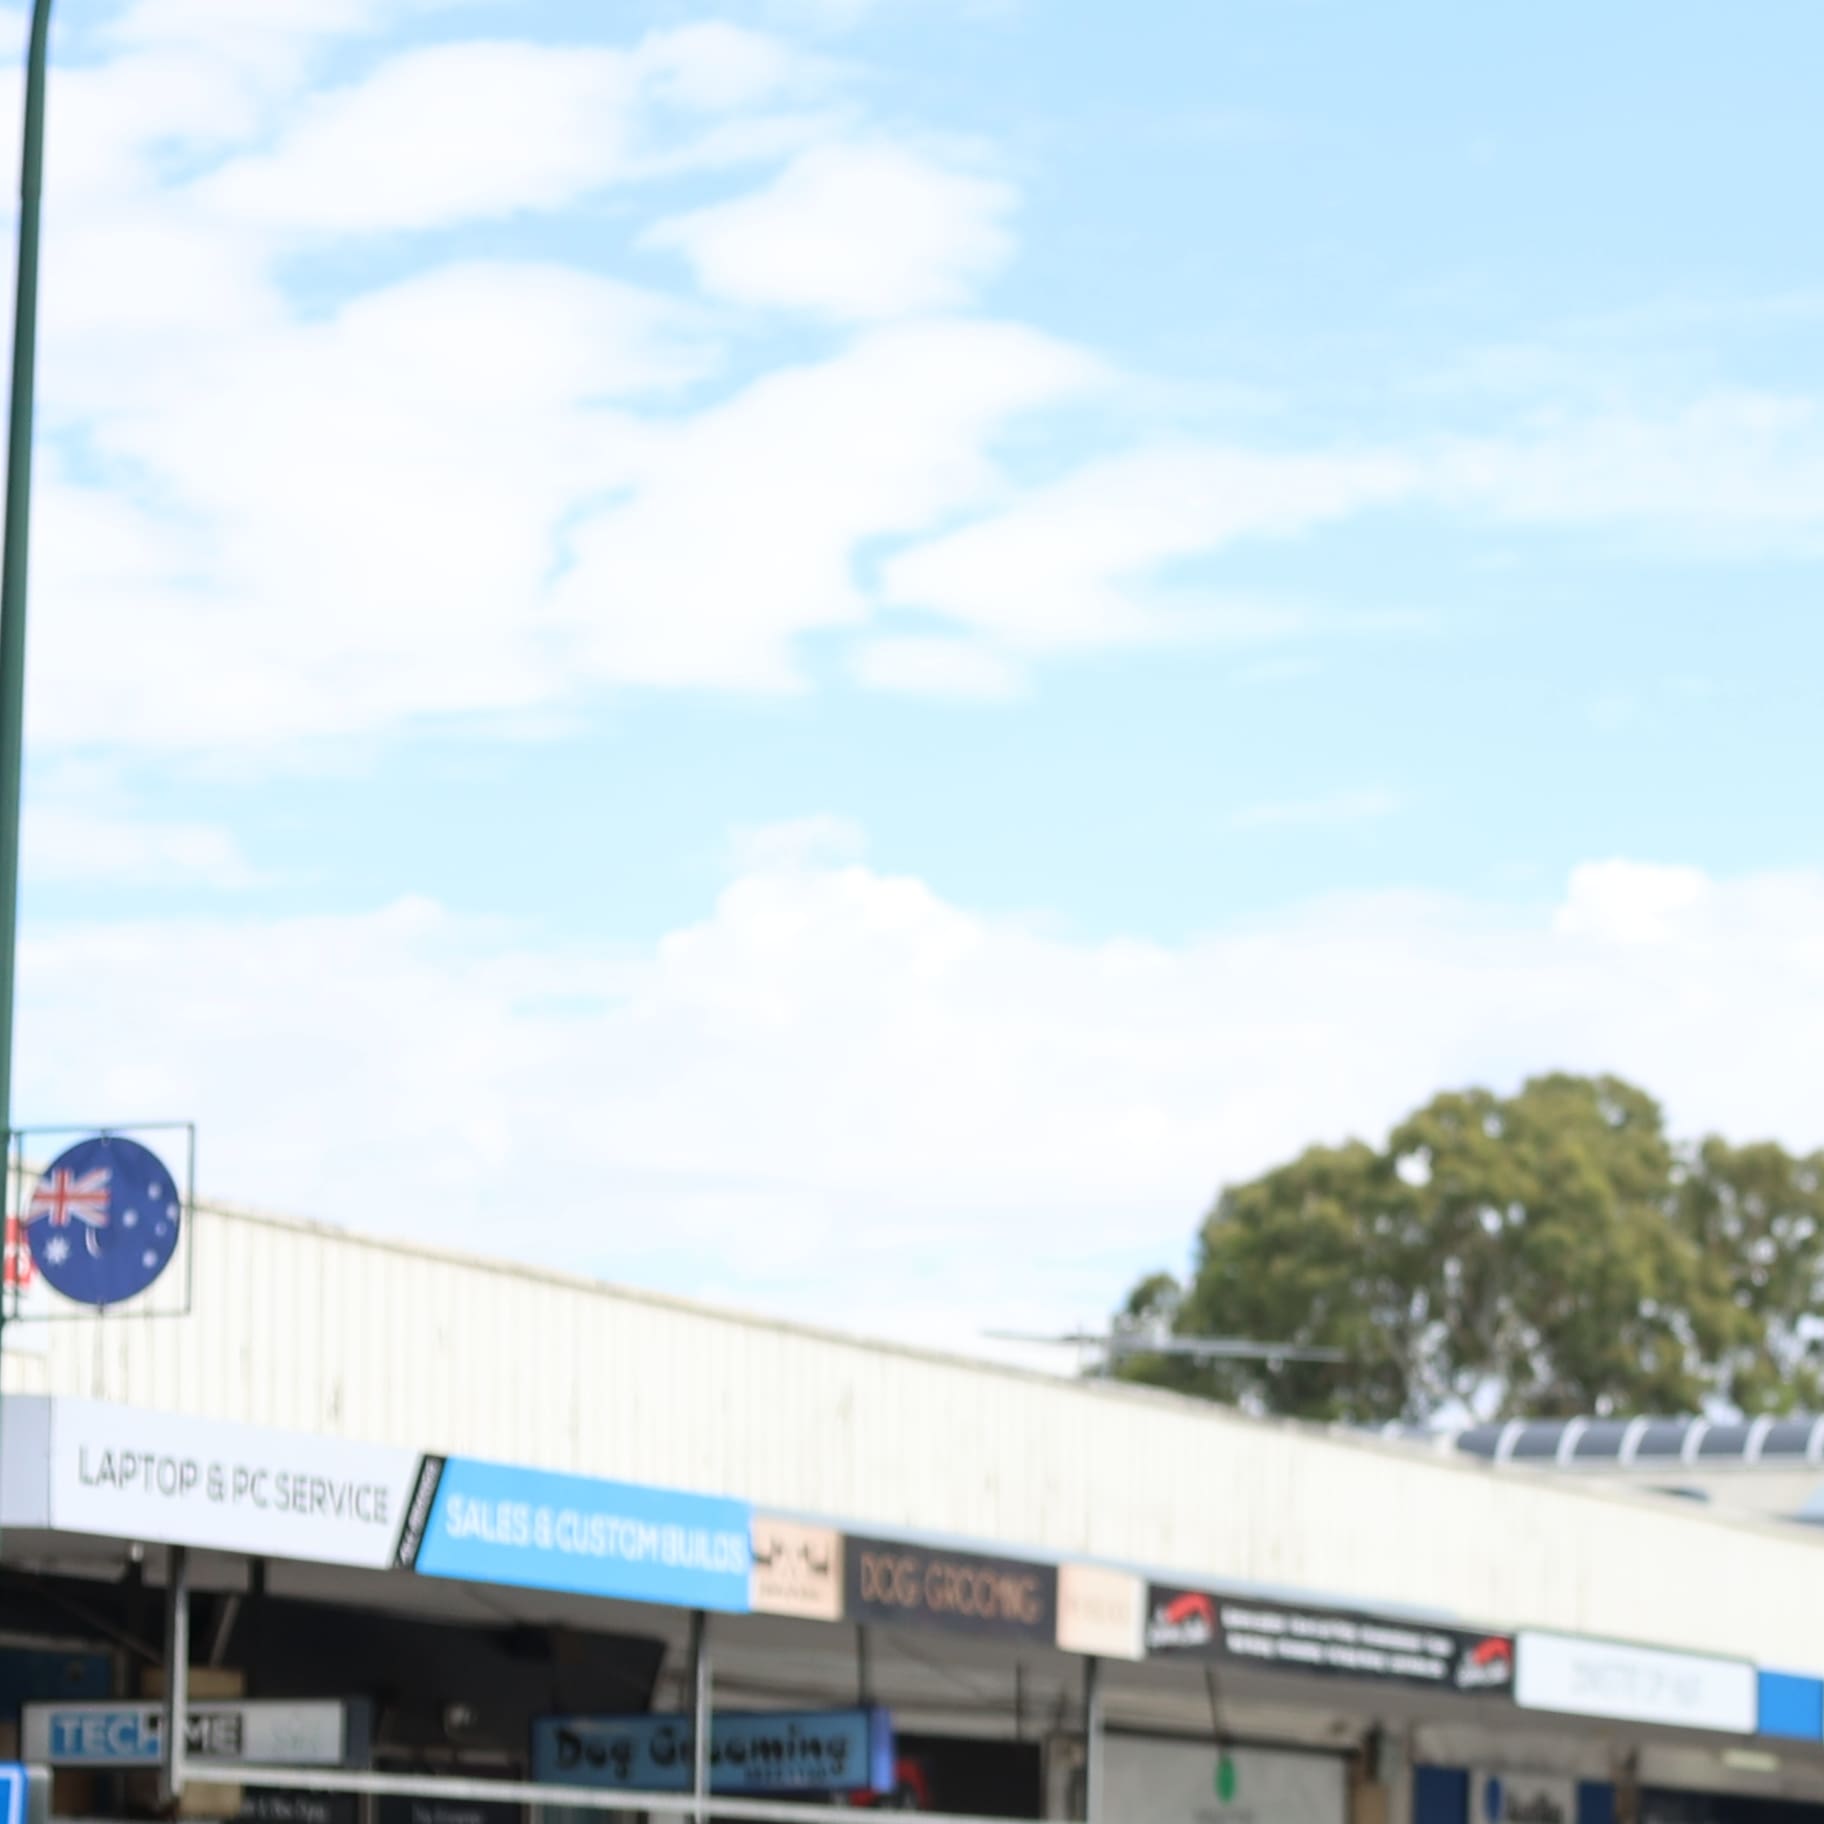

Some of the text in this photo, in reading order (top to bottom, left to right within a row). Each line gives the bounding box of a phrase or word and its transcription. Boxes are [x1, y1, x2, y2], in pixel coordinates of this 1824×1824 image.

[78, 1445, 198, 1497] LAPTOP
[233, 1465, 269, 1509] PC
[275, 1470, 389, 1525] SERVICE
[445, 1494, 529, 1549] SALES
[555, 1510, 659, 1565] CUSTOM
[661, 1527, 748, 1575] BUILDS
[860, 1550, 919, 1610] DOG
[554, 1723, 632, 1780] Dog
